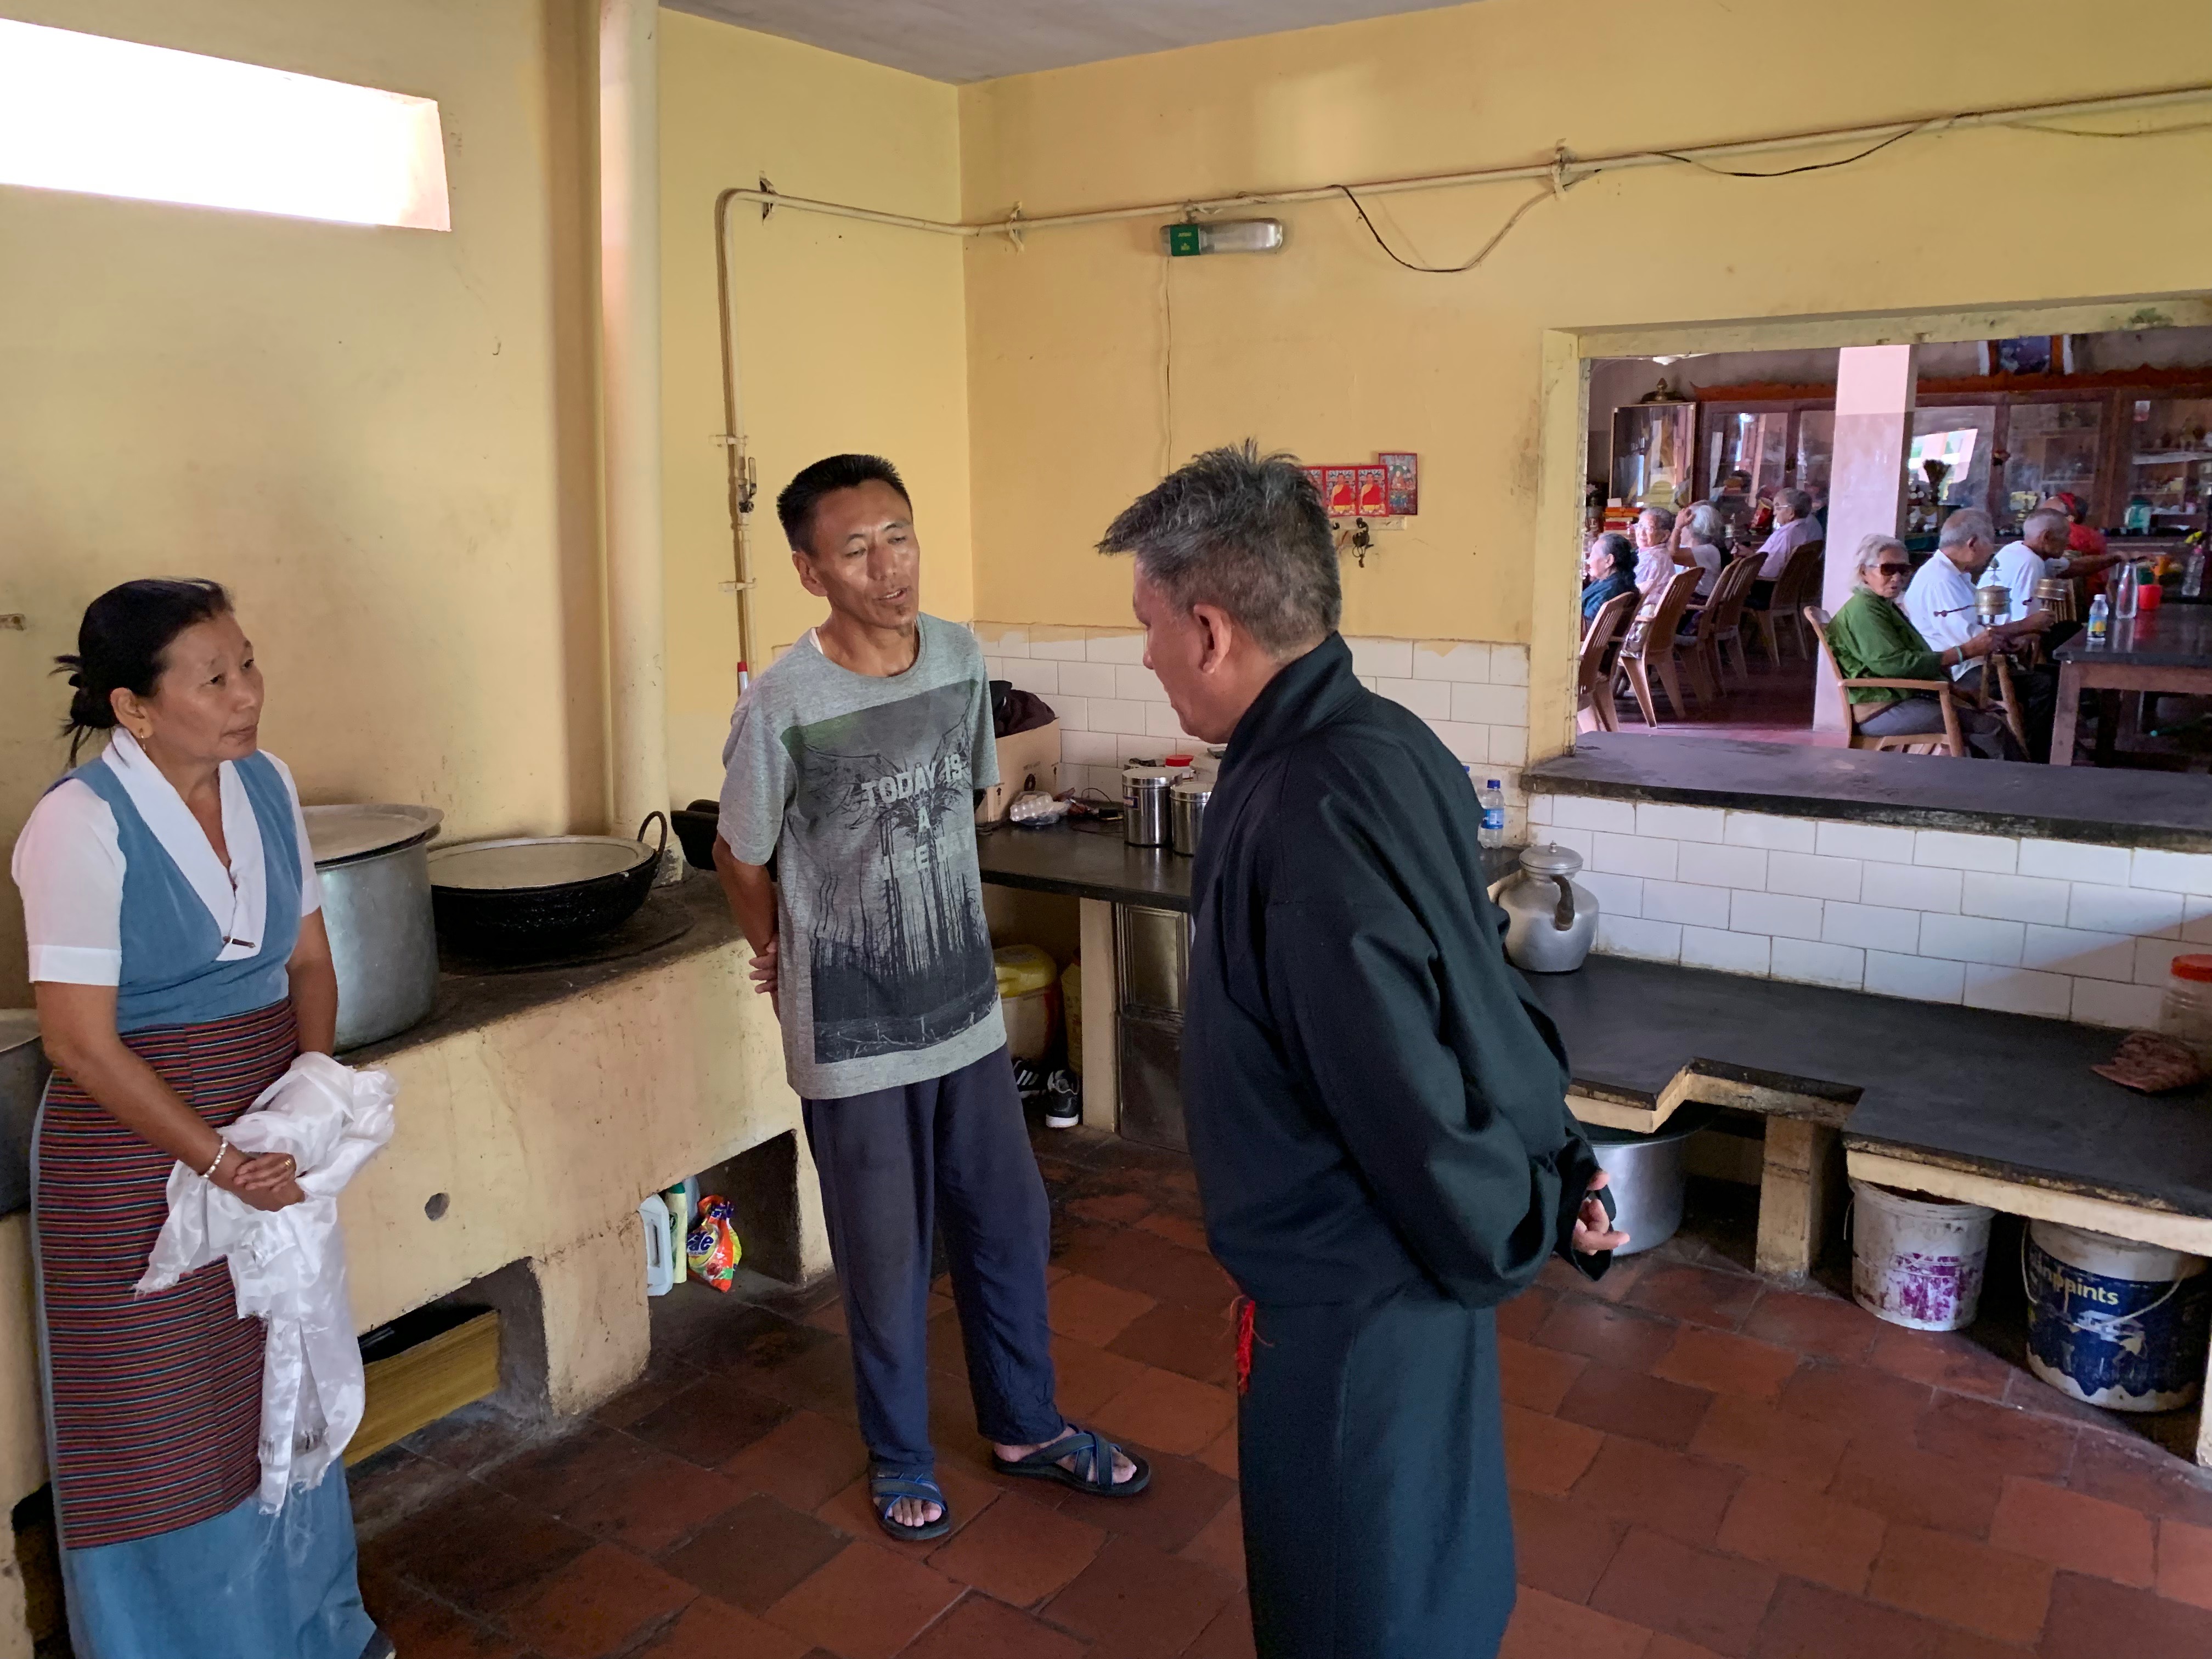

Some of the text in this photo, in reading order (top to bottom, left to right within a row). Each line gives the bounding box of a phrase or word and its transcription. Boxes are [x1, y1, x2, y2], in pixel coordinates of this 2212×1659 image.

[861, 753, 962, 809] TODAY IS
[918, 806, 931, 833] A
